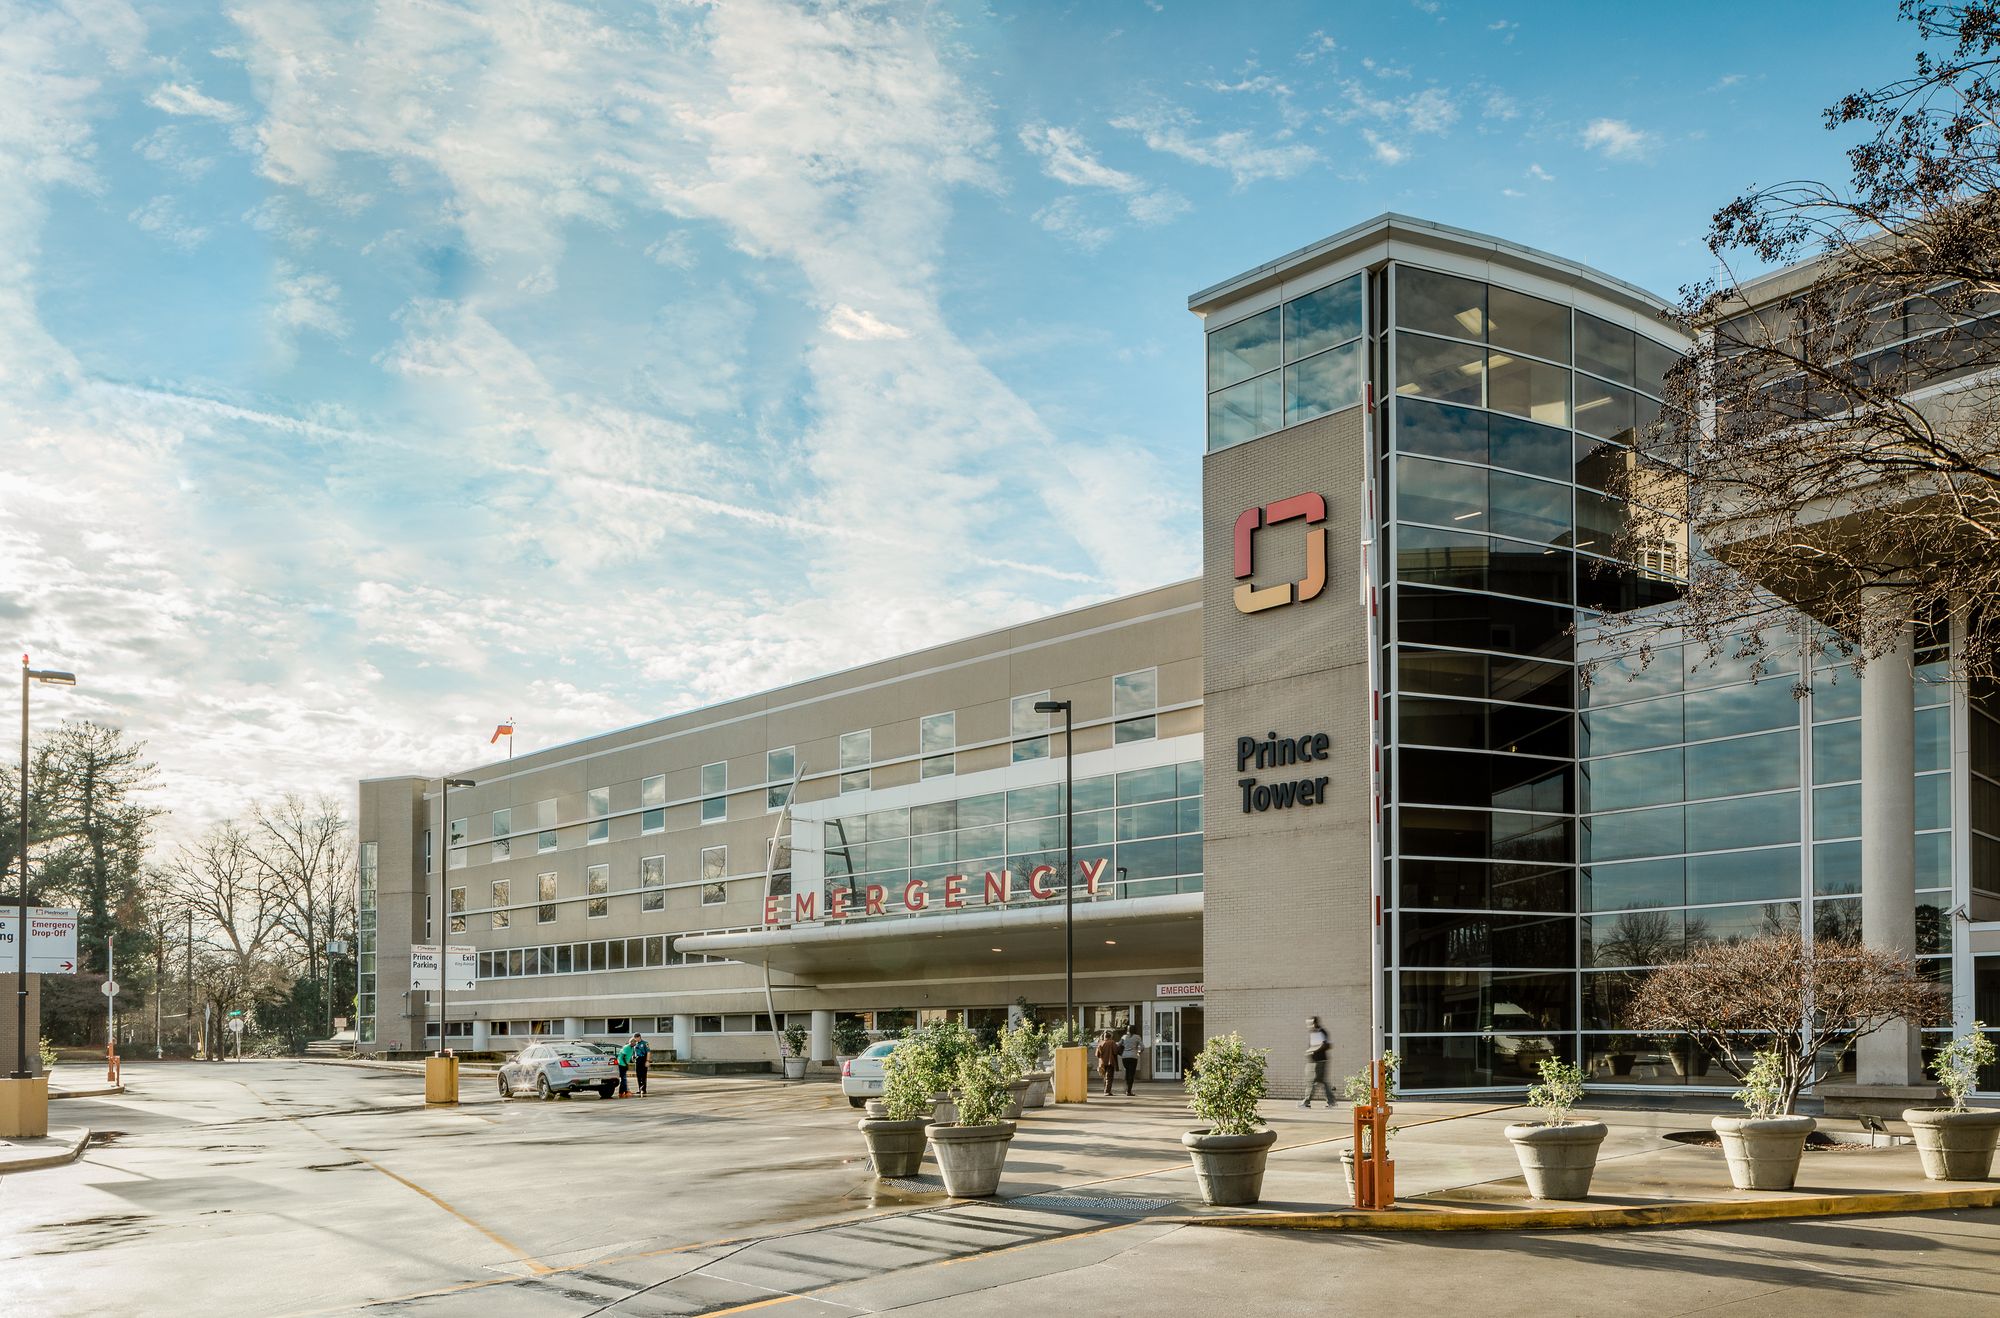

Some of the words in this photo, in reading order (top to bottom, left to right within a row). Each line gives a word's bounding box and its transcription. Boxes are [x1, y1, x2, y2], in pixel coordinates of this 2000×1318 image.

[1237, 731, 1329, 772] Prince
[1238, 776, 1329, 813] Tower
[764, 858, 1108, 925] EMERGENCY
[32, 920, 76, 930] Emergency
[32, 929, 67, 938] Drop-Off
[412, 953, 433, 961] Prince
[412, 961, 438, 970] Parking
[1161, 985, 1204, 995] EMERGENC
